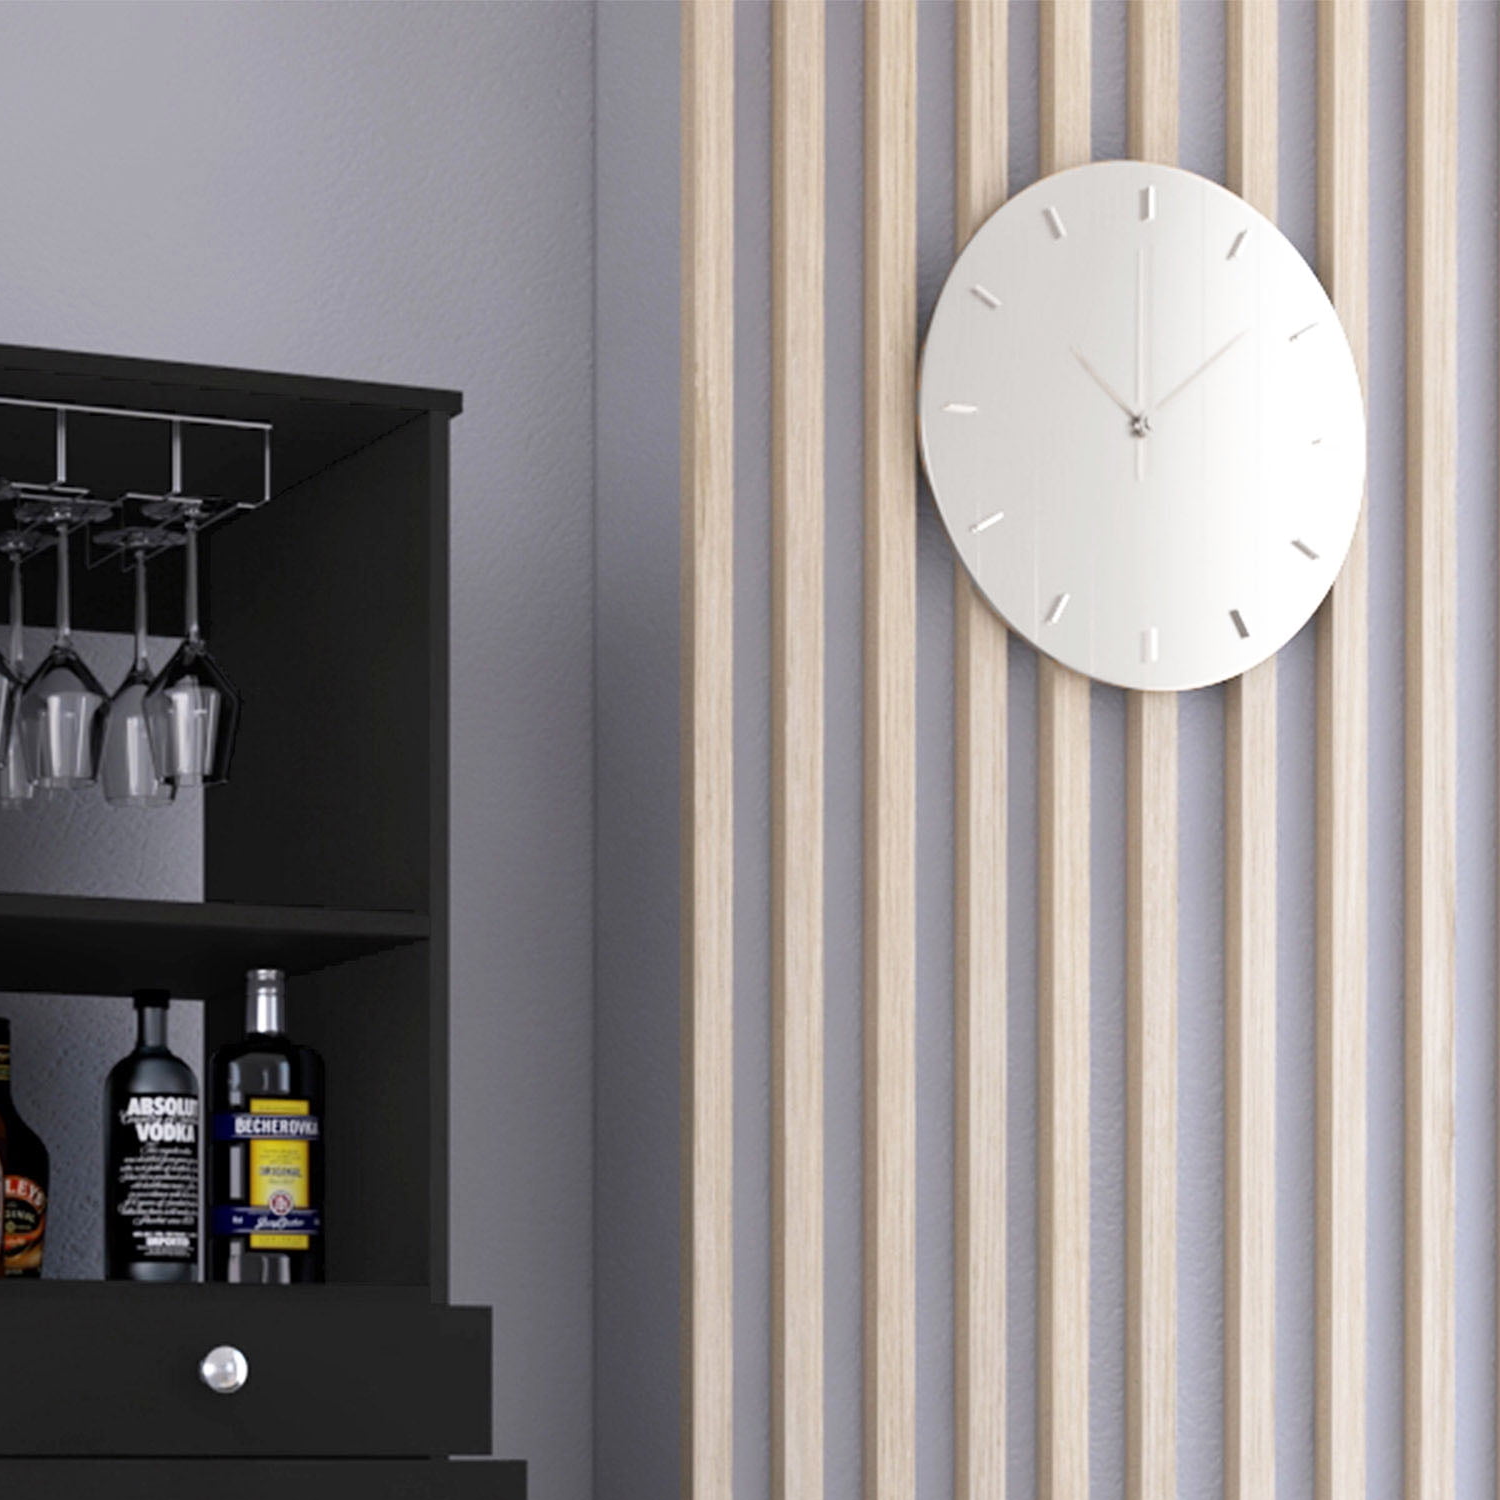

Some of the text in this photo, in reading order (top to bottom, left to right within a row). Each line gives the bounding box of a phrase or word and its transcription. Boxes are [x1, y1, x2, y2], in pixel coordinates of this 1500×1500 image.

[126, 1096, 198, 1116] ABSOLUT
[135, 1122, 195, 1142] VODKA
[235, 1116, 319, 1136] BECHEROVKA
